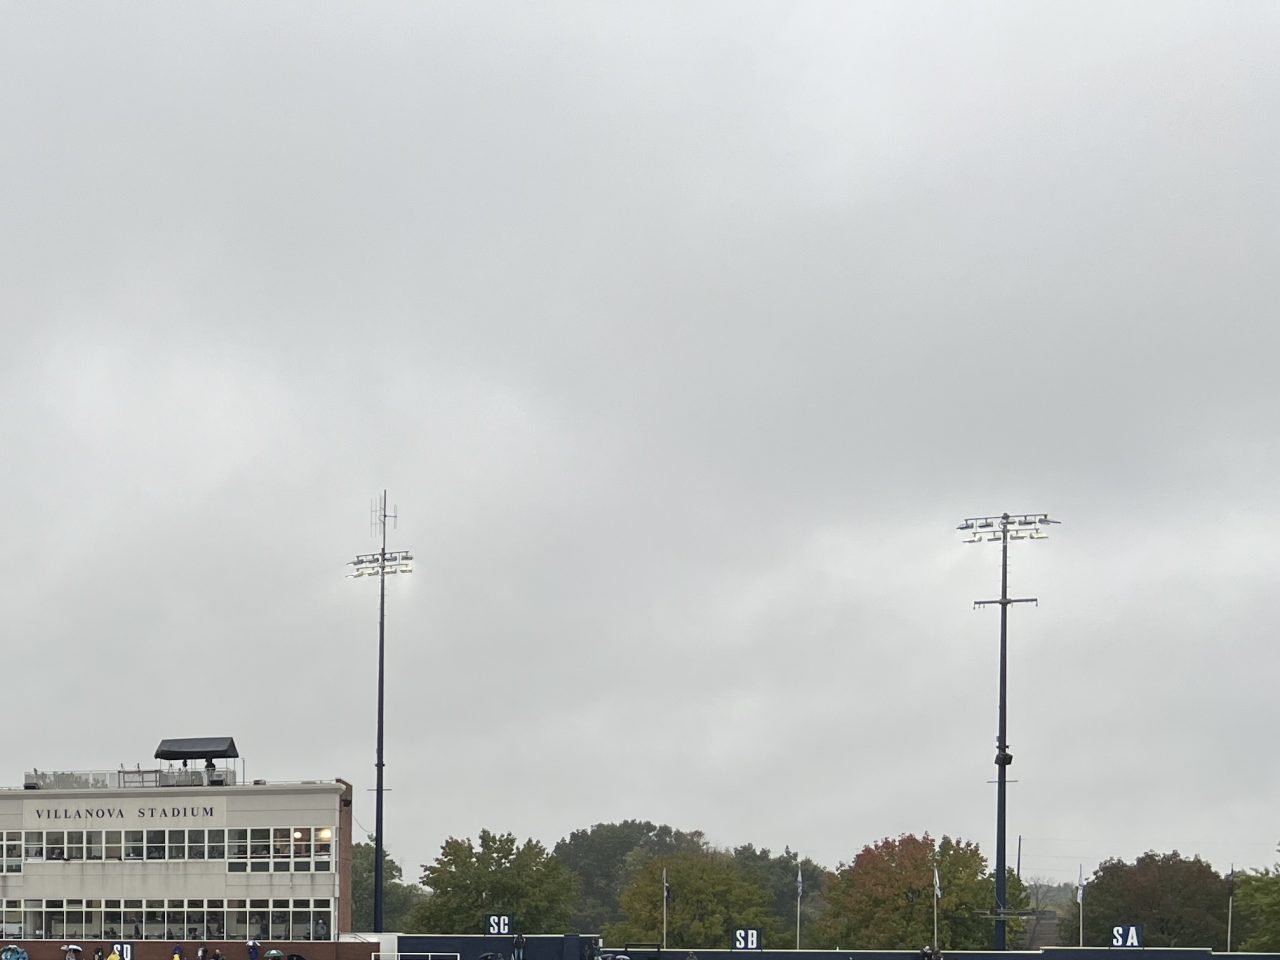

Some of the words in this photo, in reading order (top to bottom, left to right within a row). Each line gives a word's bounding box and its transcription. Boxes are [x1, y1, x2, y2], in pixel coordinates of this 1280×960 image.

[35, 808, 124, 819] VILLANOVA
[138, 806, 214, 818] STADIUM
[490, 916, 508, 934] SC
[736, 930, 757, 948] SB
[1113, 926, 1138, 946] SA
